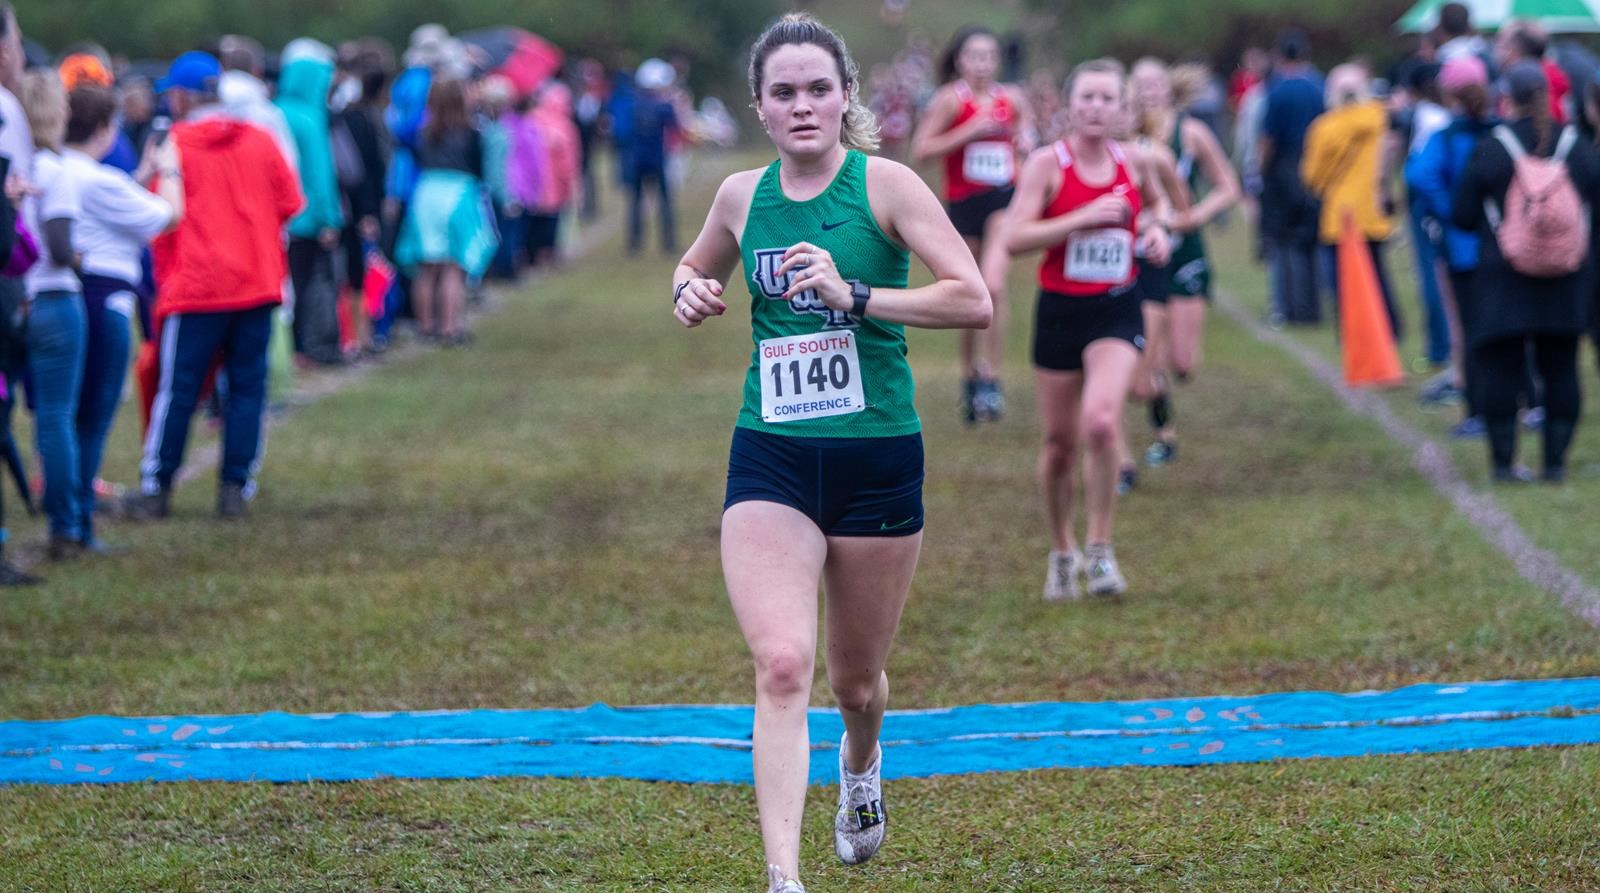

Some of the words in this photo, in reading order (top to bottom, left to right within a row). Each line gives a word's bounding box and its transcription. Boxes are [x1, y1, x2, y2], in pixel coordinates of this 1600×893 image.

[764, 343, 795, 358] GULF
[799, 337, 849, 354] SOUTH
[771, 354, 850, 397] 1140
[774, 397, 852, 415] CONFERENCE
